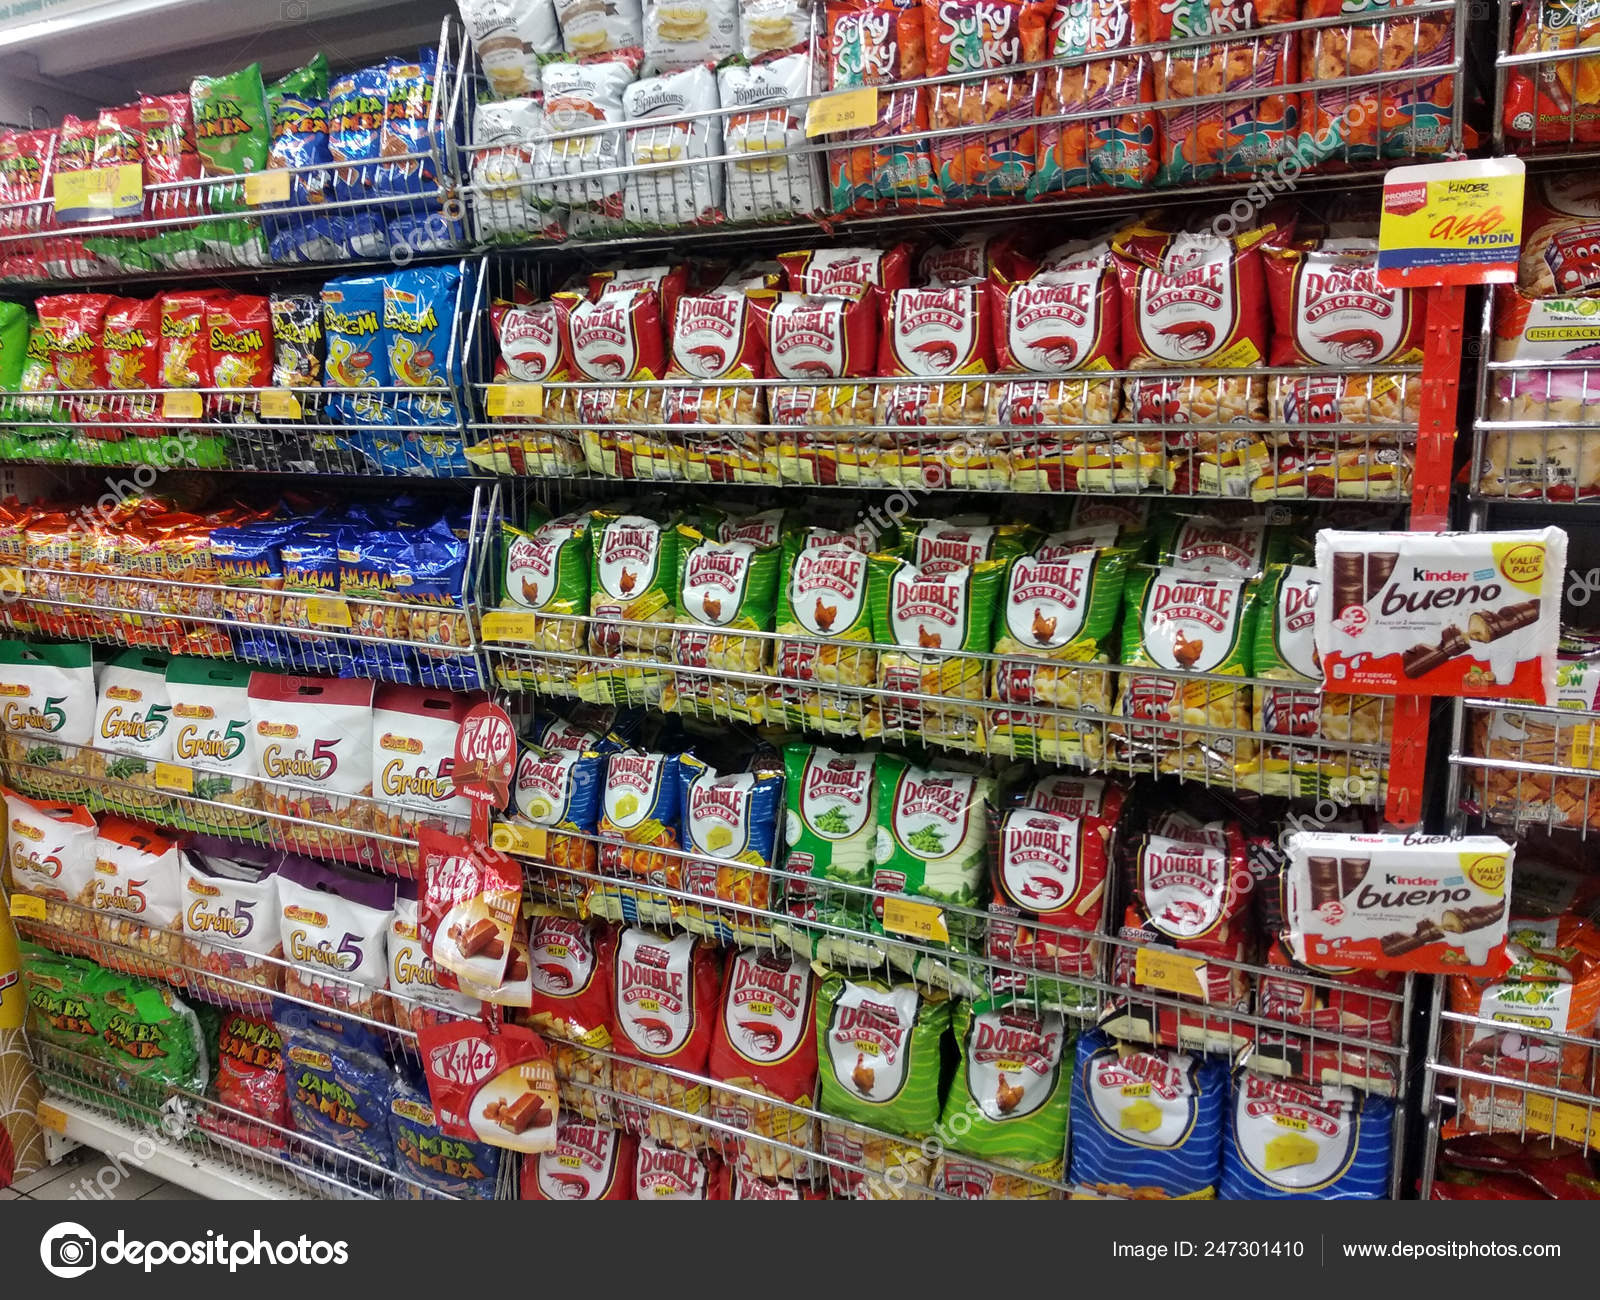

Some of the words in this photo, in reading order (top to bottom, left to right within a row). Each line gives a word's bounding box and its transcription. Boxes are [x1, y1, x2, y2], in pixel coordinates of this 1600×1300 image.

[1447, 181, 1490, 194] KINDER
[1466, 233, 1515, 246] MYDIN
[811, 262, 873, 295] DOUBLE
[1146, 262, 1225, 300] DOUBLE
[900, 289, 967, 322] DOUBLE
[1016, 283, 1091, 315] DOUBLE
[1147, 291, 1224, 316] DECKER
[1305, 295, 1394, 324] DECKER
[574, 308, 626, 338] DOUBLE
[681, 298, 739, 327] DOUBLE
[775, 309, 836, 341] DOUBLE
[901, 311, 964, 336] DECKER
[1015, 306, 1086, 331] DECKER
[506, 328, 551, 346] DECKER
[577, 330, 626, 350] DECKER
[681, 319, 734, 338] DECKER
[1530, 329, 1556, 339] FISH
[1558, 325, 1600, 338] CRACK
[777, 334, 834, 355] DECKER
[606, 530, 655, 551] DOUBLE
[919, 537, 983, 566] DOUBLE
[605, 548, 651, 566] DECKER
[689, 554, 744, 581] DOUBLE
[1508, 555, 1543, 566] VALUE
[1511, 563, 1540, 576] PACK
[690, 573, 736, 594] DECKER
[799, 557, 862, 589] DOUBLE
[1012, 563, 1084, 597] DOUBLE
[798, 578, 855, 600] DECKER
[896, 582, 960, 614] DOUBLE
[1013, 585, 1077, 610] DECKER
[1380, 581, 1503, 618] bueno
[1153, 584, 1233, 620] DOUBLE
[898, 604, 957, 627] DECKER
[1152, 604, 1225, 633] DECKER
[509, 626, 524, 635] 1.20
[464, 716, 511, 766] KitKat
[520, 759, 565, 789] DOUBLE
[610, 755, 656, 777] DOUBLE
[519, 778, 560, 799] DECKER
[608, 775, 649, 793] DECKER
[809, 766, 867, 794] DOUBLE
[692, 785, 744, 815] DOUBLE
[809, 785, 862, 804] DECKER
[694, 806, 739, 826] DECKER
[1010, 831, 1072, 862] DOUBLE
[1011, 854, 1068, 872] DECKER
[1149, 853, 1220, 884] DOUBLE
[1152, 877, 1215, 897] DECKER
[1356, 884, 1472, 909] bueno
[913, 921, 932, 931] 1.20
[548, 946, 567, 957] MINI
[621, 959, 684, 1001] DOUBLE
[734, 959, 802, 1007] DOUBLE
[1143, 967, 1166, 980] 1.20
[623, 988, 684, 1014] DECKER
[639, 1000, 660, 1011] MINI
[733, 989, 796, 1020] DECKER
[750, 1003, 773, 1014] MINI
[109, 1014, 168, 1042] SAMBA
[228, 1016, 283, 1049] SAMBA
[856, 1041, 879, 1054] MINI
[975, 1021, 1058, 1062] DOUBLE
[441, 1037, 494, 1084] KitKat
[998, 1061, 1024, 1072] MINI
[297, 1071, 358, 1110] SAMBA
[1123, 1085, 1151, 1096] MINI
[1275, 1116, 1308, 1130] MINI
[559, 1156, 581, 1167] MINI
